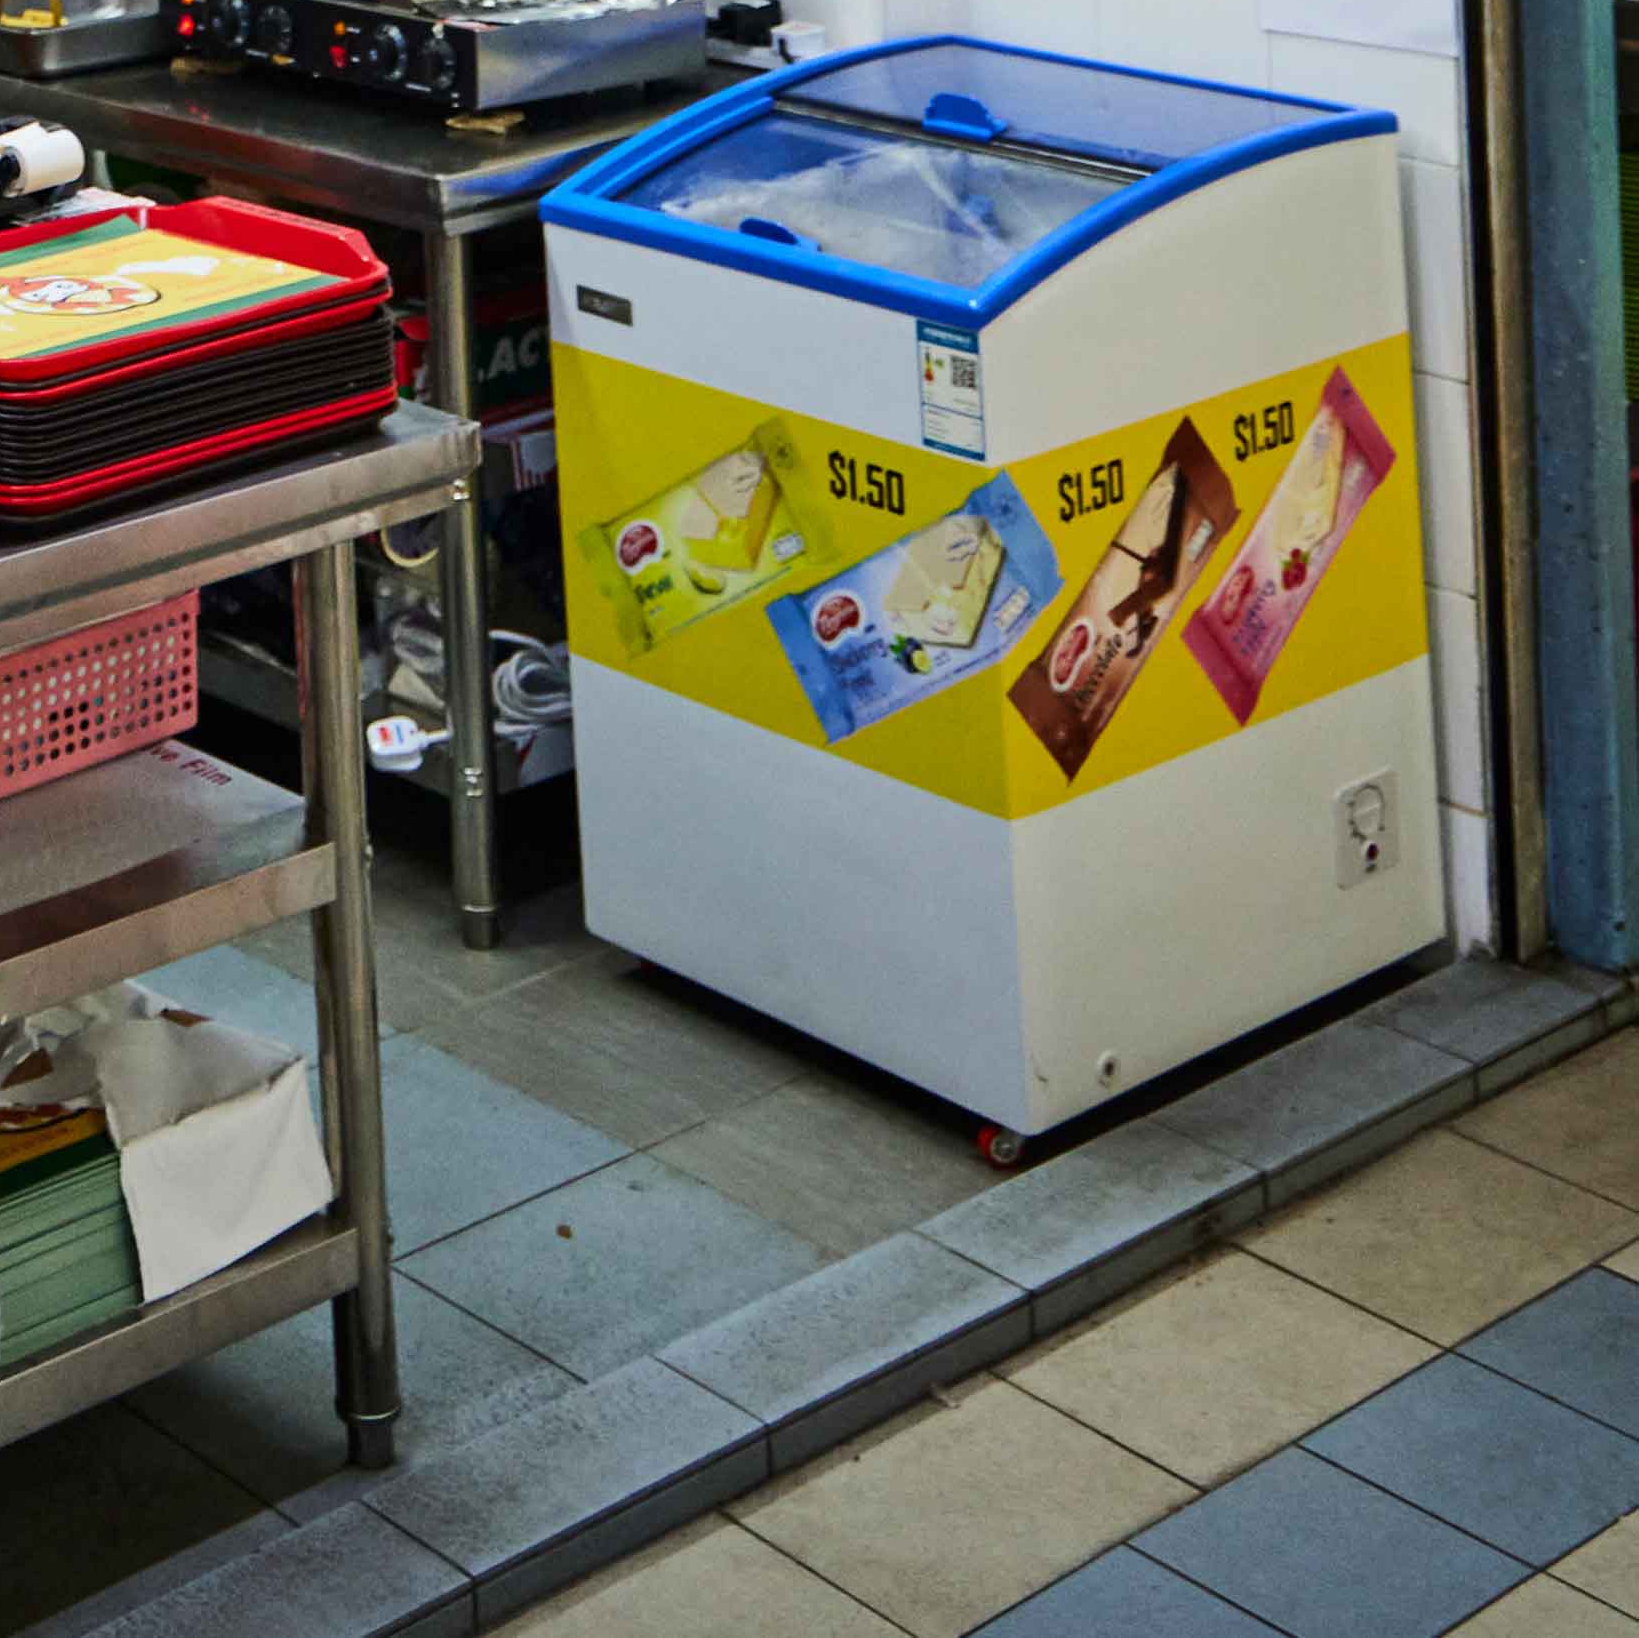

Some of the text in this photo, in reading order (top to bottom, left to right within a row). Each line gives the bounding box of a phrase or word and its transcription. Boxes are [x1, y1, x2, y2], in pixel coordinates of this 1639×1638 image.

[1234, 400, 1295, 462] $1.50
[828, 450, 905, 516] $1.50
[1058, 458, 1124, 523] $1.50
[181, 758, 233, 787] Film
